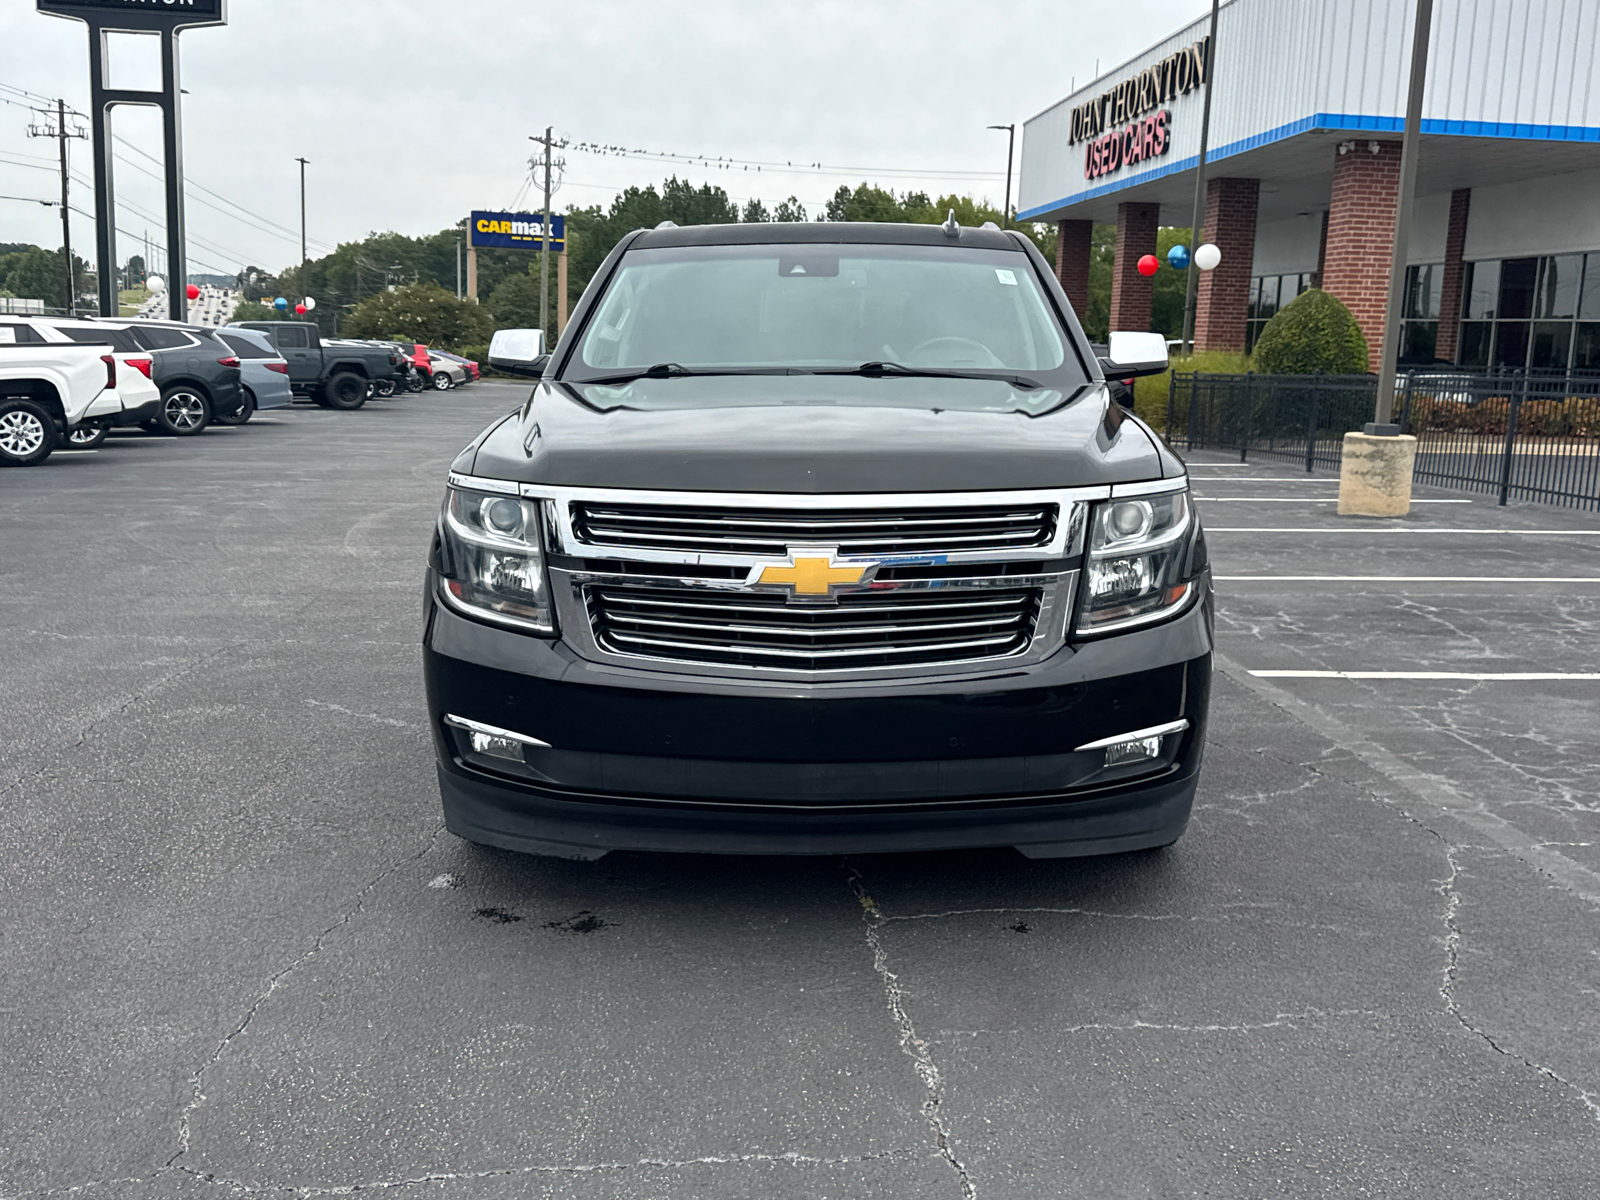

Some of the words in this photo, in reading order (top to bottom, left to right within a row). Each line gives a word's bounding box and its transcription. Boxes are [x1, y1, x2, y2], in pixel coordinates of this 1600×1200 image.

[1067, 94, 1106, 146] JOHN
[1106, 36, 1210, 128] THORNTON
[1084, 131, 1123, 180] USED
[1122, 110, 1171, 166] CARS
[476, 219, 554, 237] CARmax
